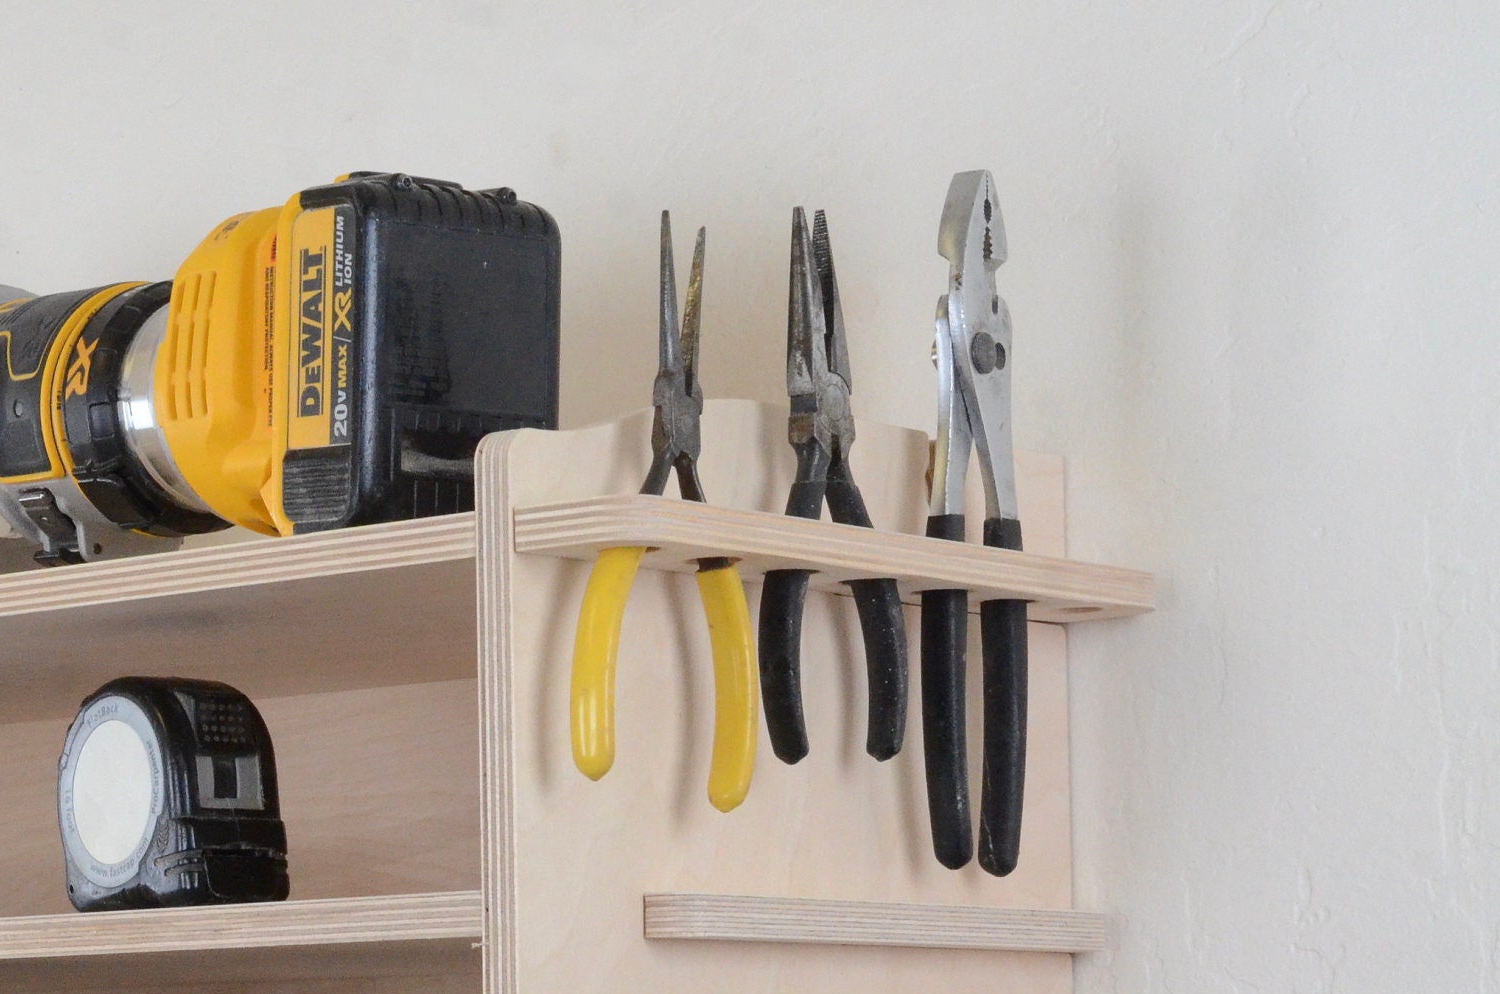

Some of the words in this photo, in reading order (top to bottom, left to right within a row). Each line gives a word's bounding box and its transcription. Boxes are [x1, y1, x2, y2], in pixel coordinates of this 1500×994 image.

[335, 216, 345, 287] LITHIUM
[344, 253, 352, 285] ION
[301, 248, 324, 417] DEWALT
[334, 288, 352, 331] XR
[65, 336, 99, 400] XR
[338, 344, 349, 388] MAX
